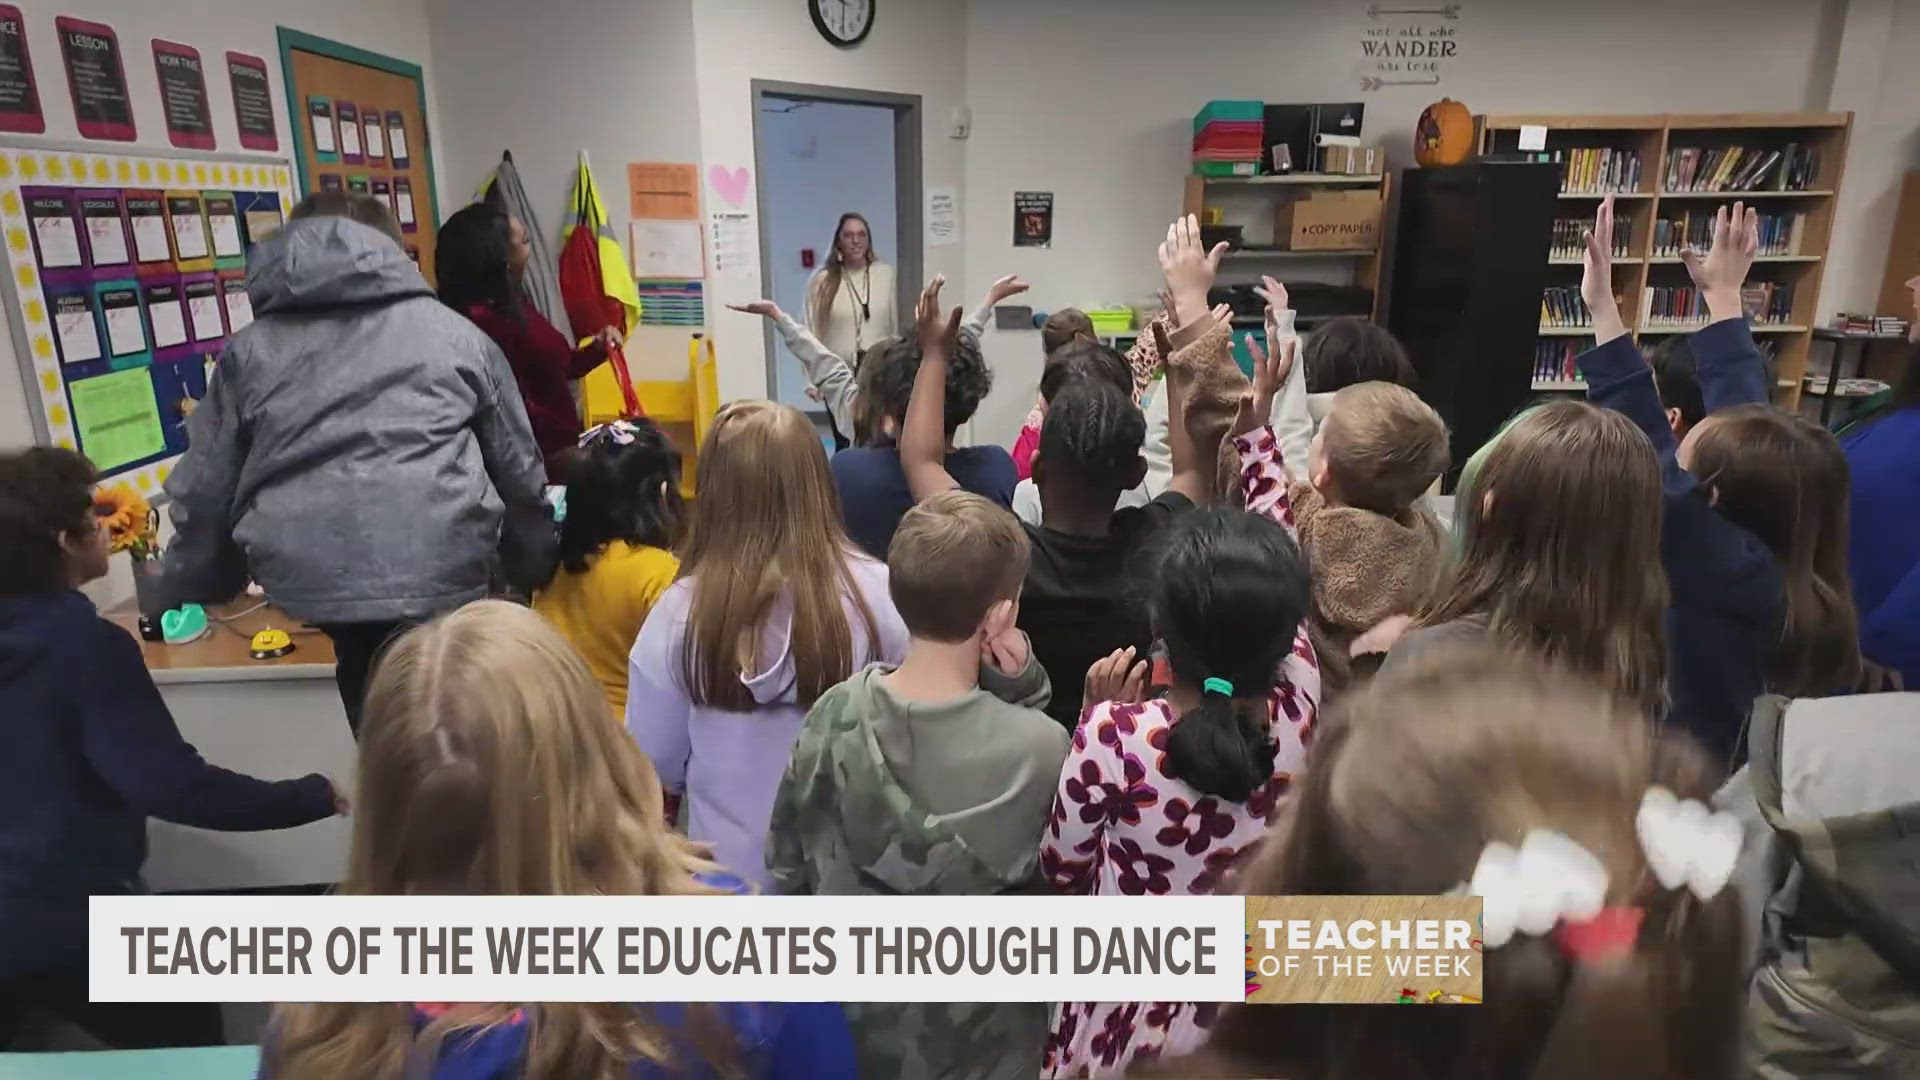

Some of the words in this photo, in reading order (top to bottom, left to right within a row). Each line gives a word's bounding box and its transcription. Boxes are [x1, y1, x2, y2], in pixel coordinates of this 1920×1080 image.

[1429, 27, 1455, 37] who
[69, 33, 109, 51] LESSON
[1361, 40, 1457, 58] WANDER
[1309, 224, 1338, 235] COPY
[1340, 223, 1372, 234] PAPER
